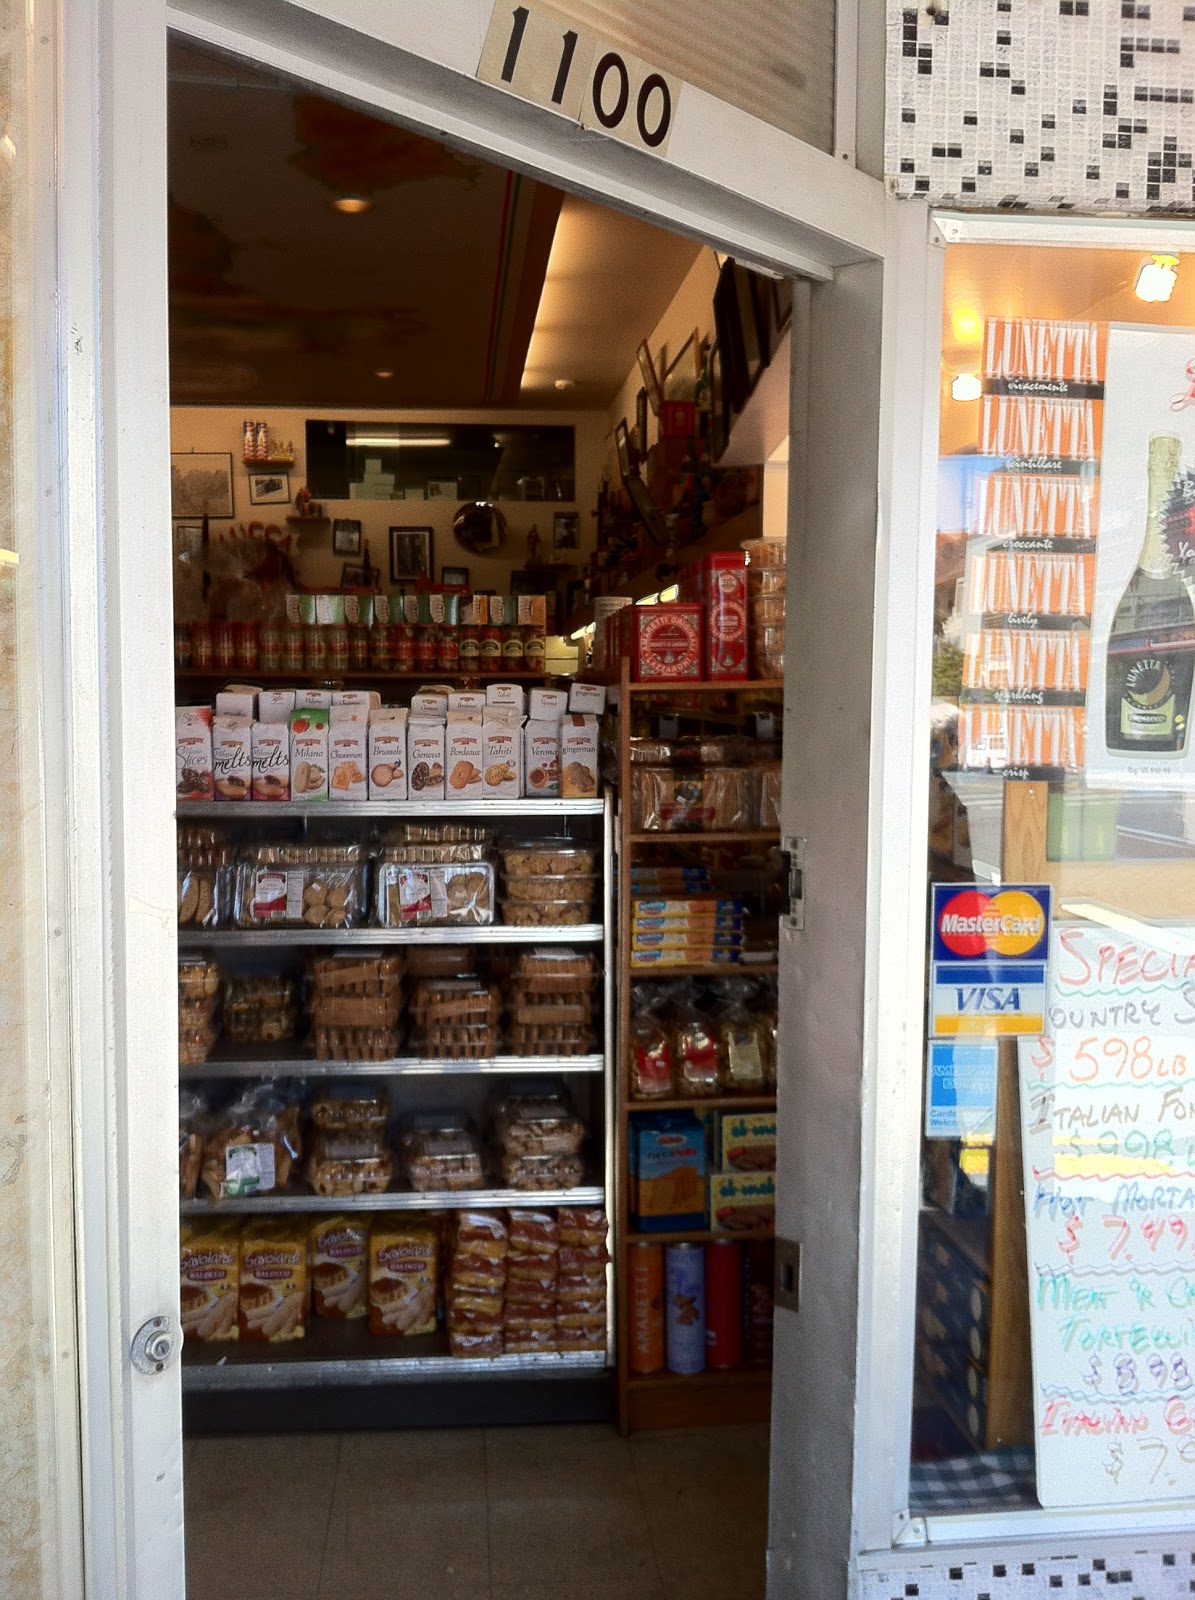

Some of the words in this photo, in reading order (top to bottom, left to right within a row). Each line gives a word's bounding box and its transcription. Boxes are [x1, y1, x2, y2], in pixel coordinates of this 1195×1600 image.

[501, 6, 671, 147] 1100
[985, 317, 1099, 384] LUNETTA
[980, 396, 1095, 461] LUNETTA
[1125, 659, 1161, 688] LUNETTA
[412, 749, 441, 759] Geneva
[450, 746, 481, 756] Bordeaux
[488, 745, 513, 757] Tahiti
[940, 913, 1041, 935] MasterCard
[955, 987, 1020, 1011] VISA
[1049, 999, 1161, 1029] OUNTRY
[1027, 1086, 1140, 1136] ITALIAN
